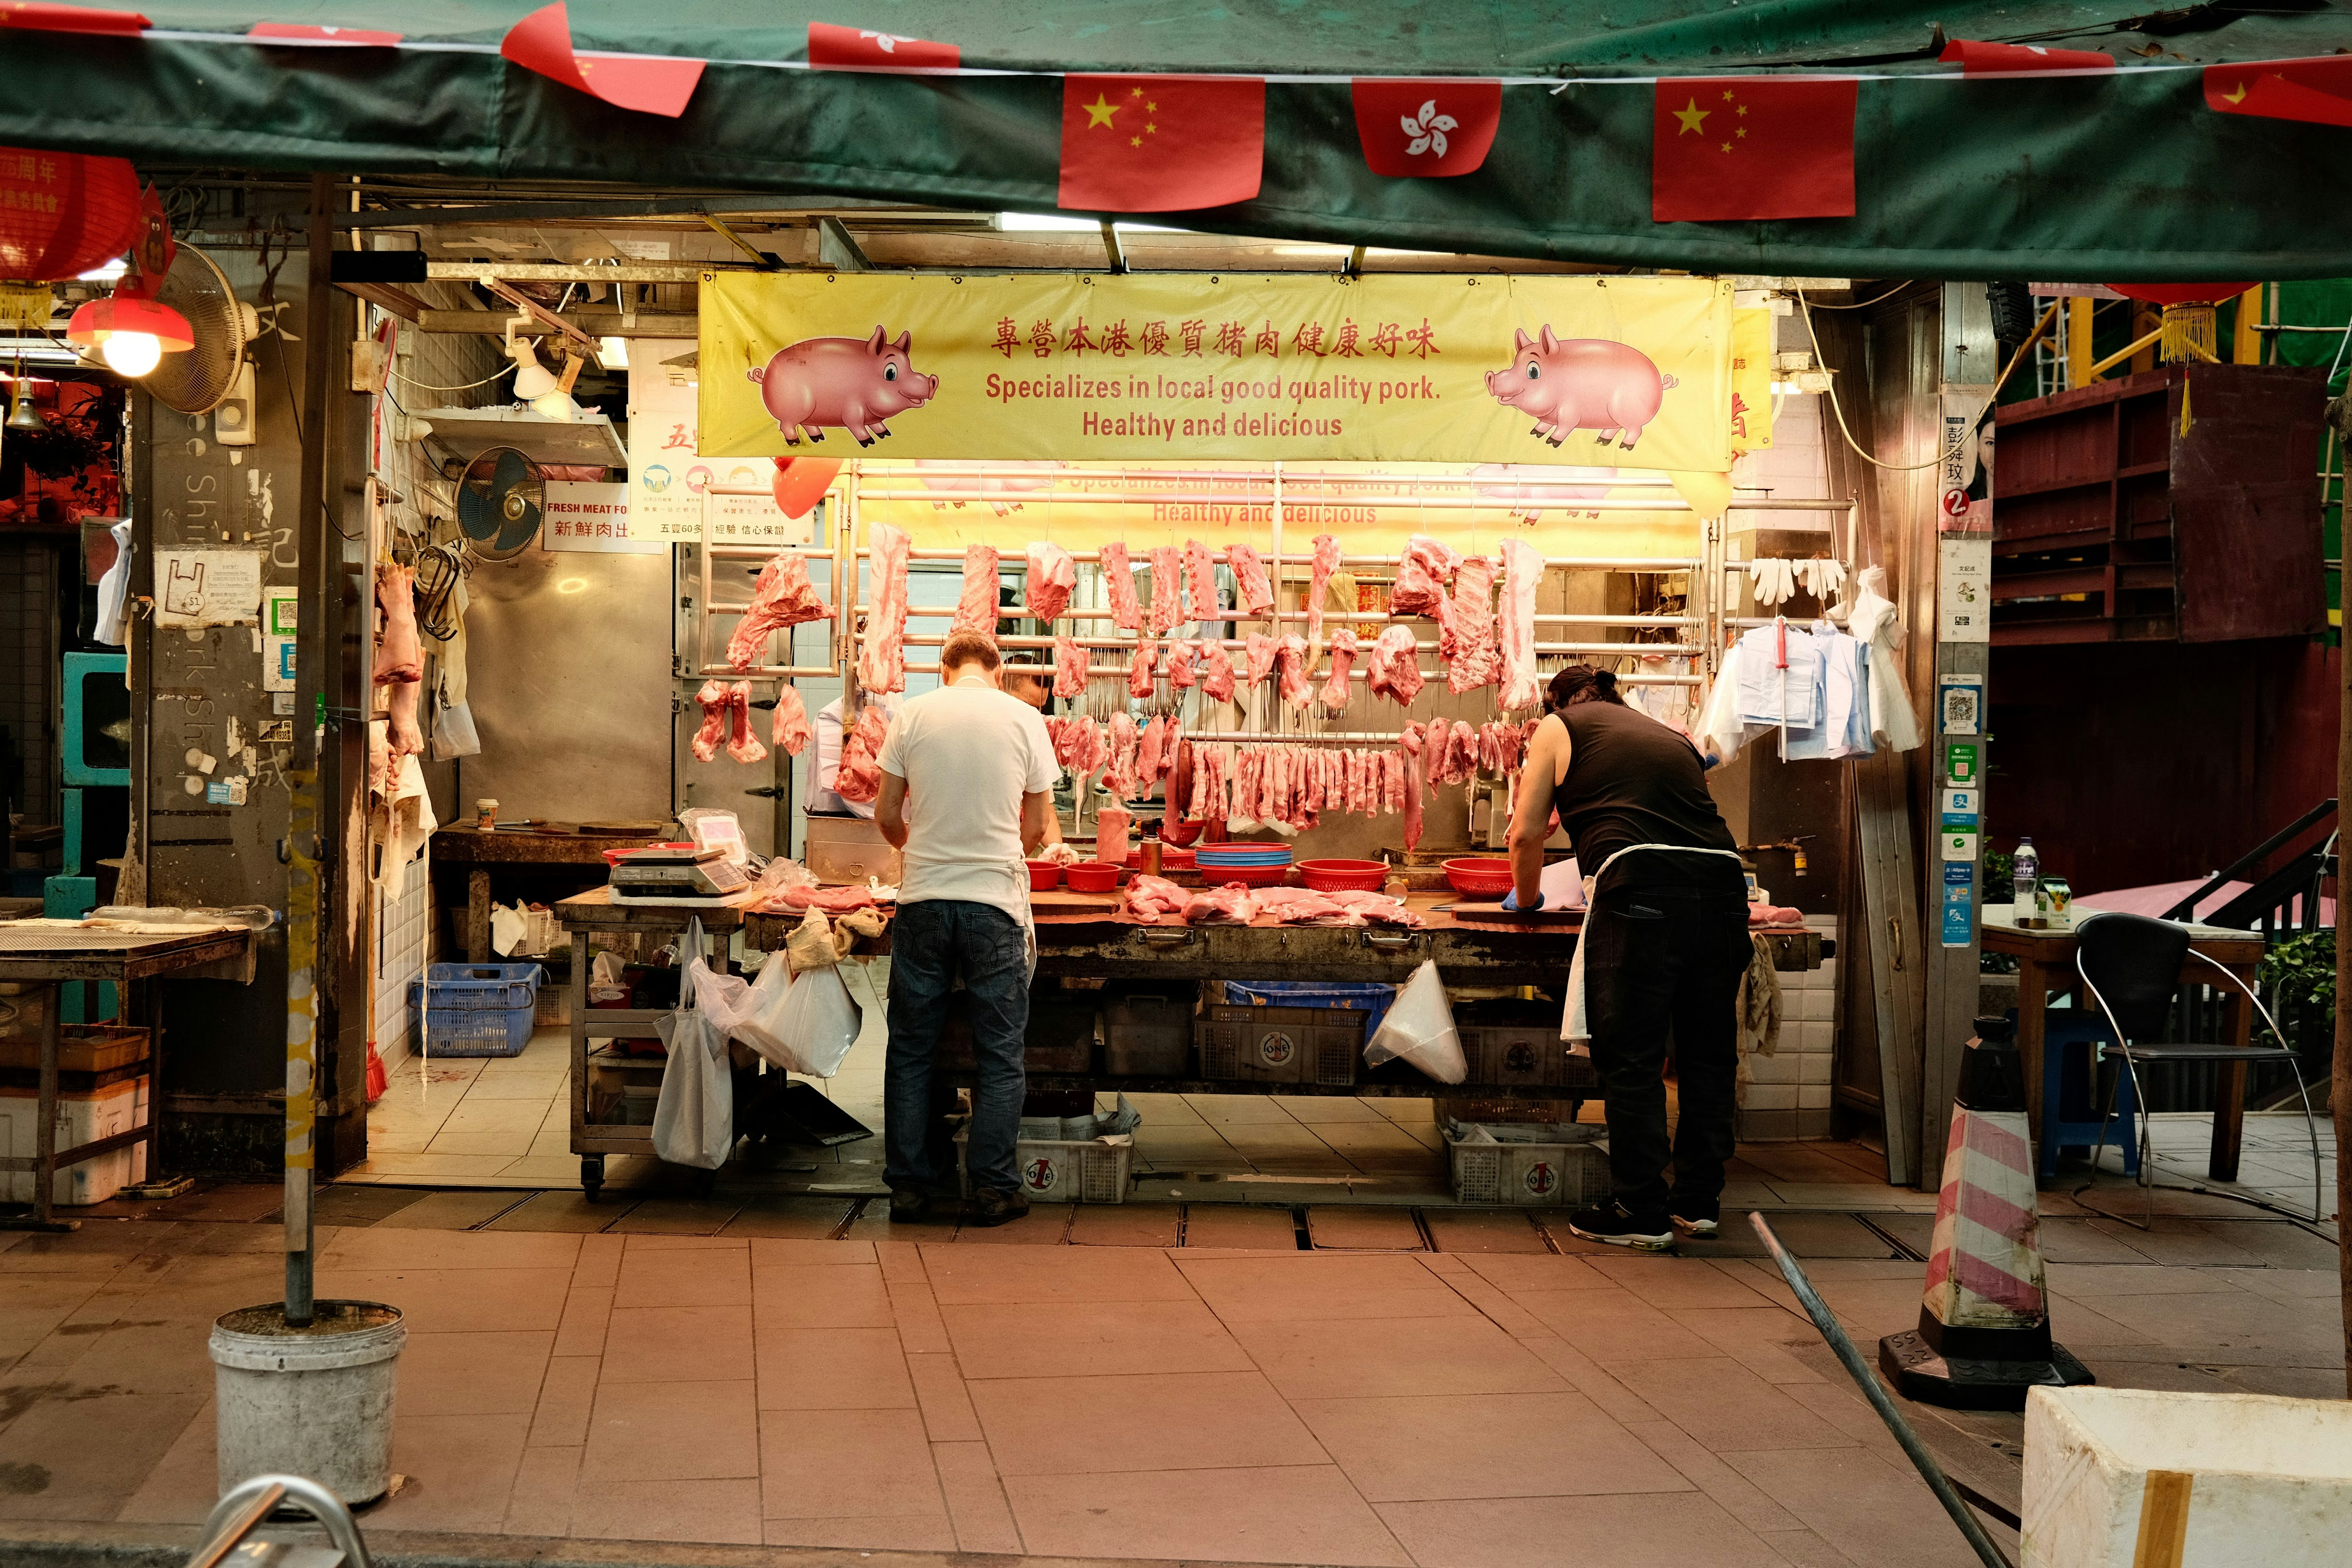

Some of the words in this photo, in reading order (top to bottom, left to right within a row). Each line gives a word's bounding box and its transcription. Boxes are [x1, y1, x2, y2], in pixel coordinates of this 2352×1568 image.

[986, 373, 1121, 403] Specializes
[1129, 374, 1149, 397] in
[1157, 375, 1213, 398] local
[1221, 375, 1280, 403] good
[1289, 375, 1372, 404] quality
[1379, 375, 1440, 404] pork.
[1082, 412, 1176, 441] Healthy
[1182, 413, 1226, 436] and
[1233, 413, 1343, 437] delicious
[547, 503, 580, 513] FRESH
[583, 504, 611, 514] MEAT
[1948, 490, 1966, 515] 2
[1153, 503, 1231, 527] Healthy
[1283, 504, 1376, 523] delicious
[661, 524, 736, 535] 五豐60多經驗
[741, 525, 785, 535] 信心保證
[276, 730, 287, 740] 1938
